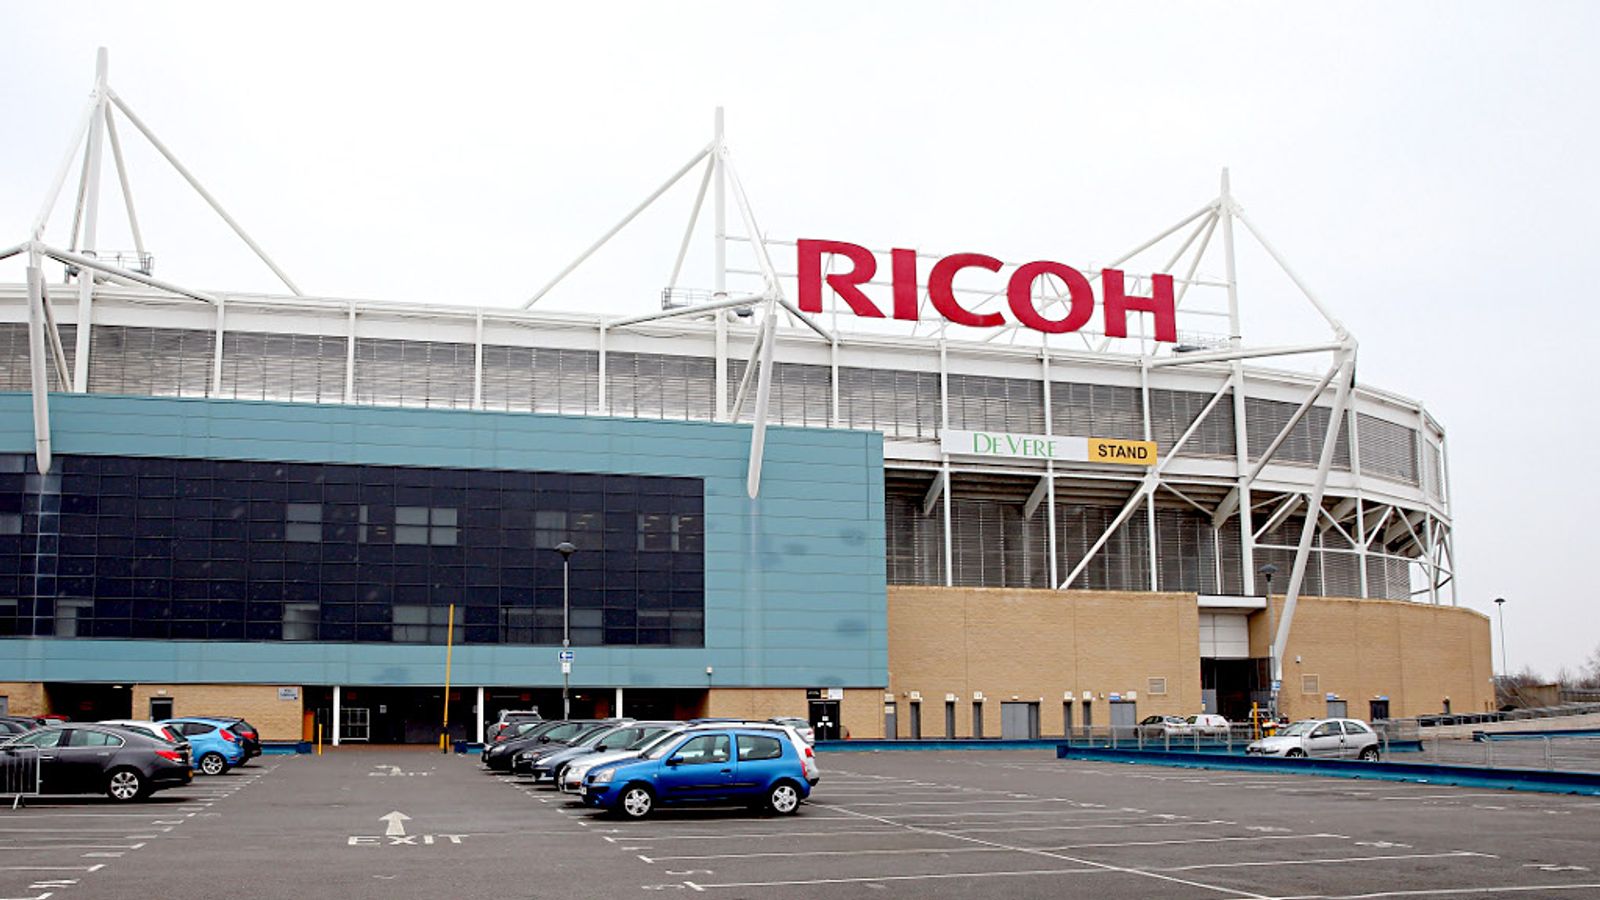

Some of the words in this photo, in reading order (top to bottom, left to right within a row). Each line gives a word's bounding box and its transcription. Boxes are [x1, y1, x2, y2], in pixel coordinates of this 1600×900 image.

[797, 239, 1177, 343] RICOH
[1098, 444, 1148, 460] STAND
[347, 834, 470, 846] EXIT
